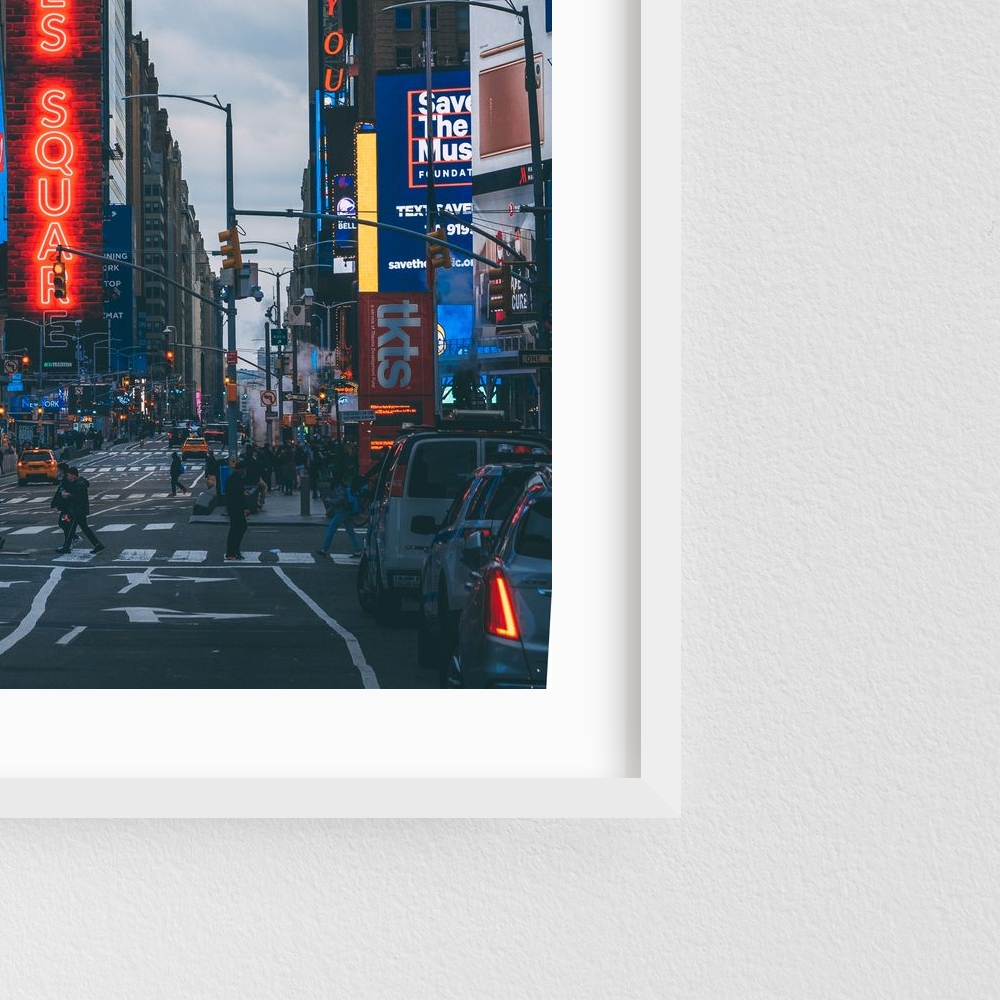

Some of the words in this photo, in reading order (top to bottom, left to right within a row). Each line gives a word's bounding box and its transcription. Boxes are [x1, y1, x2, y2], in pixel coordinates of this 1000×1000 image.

[418, 115, 468, 138] The
[418, 138, 472, 162] Mus
[418, 168, 473, 179] FUNDAT
[34, 89, 75, 349] SQUARE
[337, 222, 357, 230] BELL
[446, 223, 473, 236] 919
[376, 300, 421, 389] tkts
